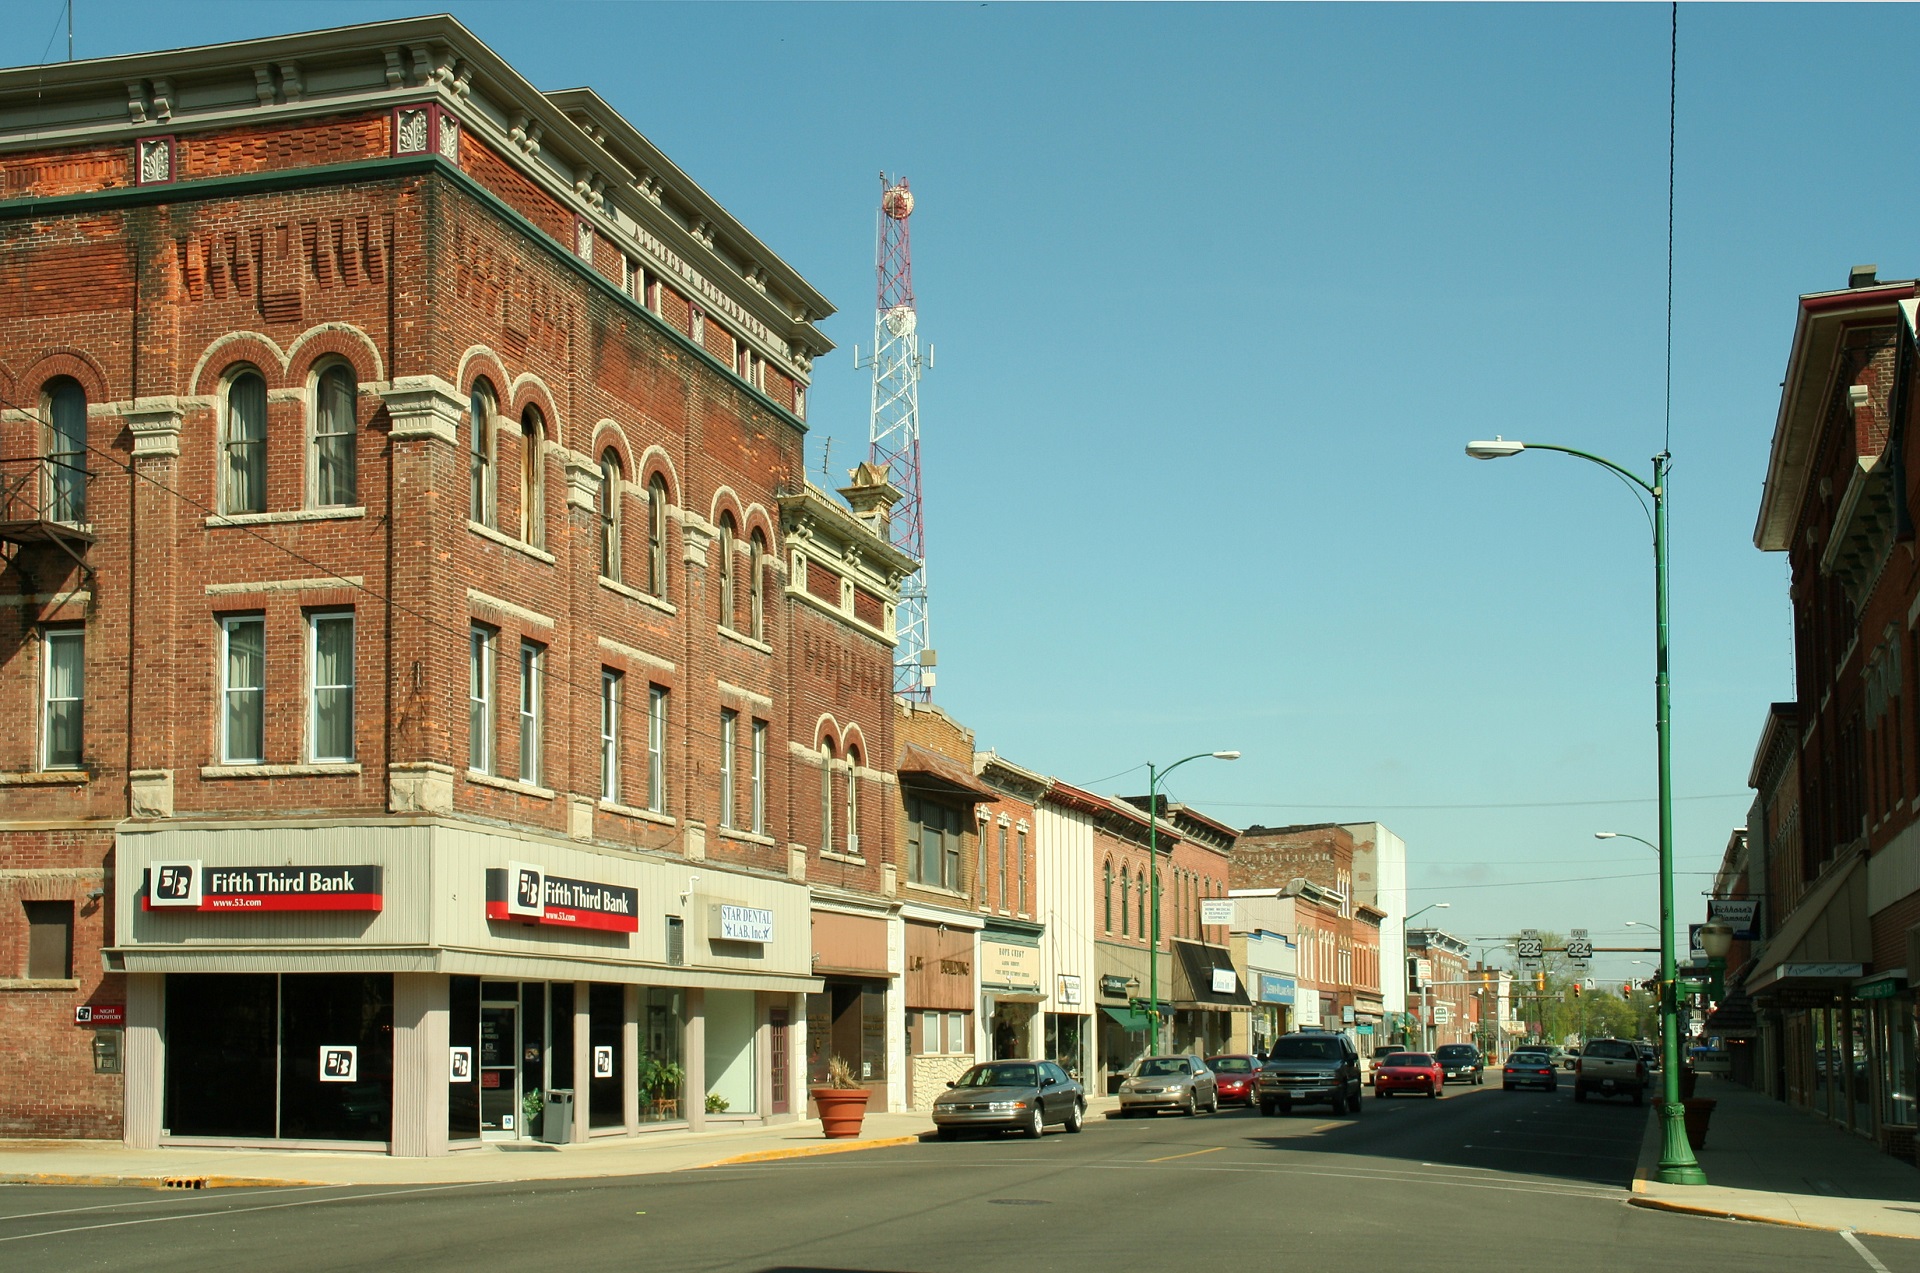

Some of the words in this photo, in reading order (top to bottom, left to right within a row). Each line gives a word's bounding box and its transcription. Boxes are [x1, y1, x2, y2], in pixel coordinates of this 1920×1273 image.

[212, 872, 254, 893] Fifth
[256, 871, 304, 892] Third
[309, 871, 355, 892] Bank
[213, 898, 262, 907] www.53.com
[545, 881, 571, 906] Fifth
[572, 885, 601, 909] Third
[603, 890, 629, 914] Bank
[545, 911, 576, 922] www.53.com
[722, 906, 742, 921] STAR
[743, 908, 772, 925] DENTAL
[733, 923, 750, 939] LAB,
[751, 925, 763, 940] Inc.
[1519, 943, 1542, 953] 224
[1569, 943, 1592, 953] 224
[909, 955, 924, 971] LAW
[940, 959, 969, 976] BUILDING
